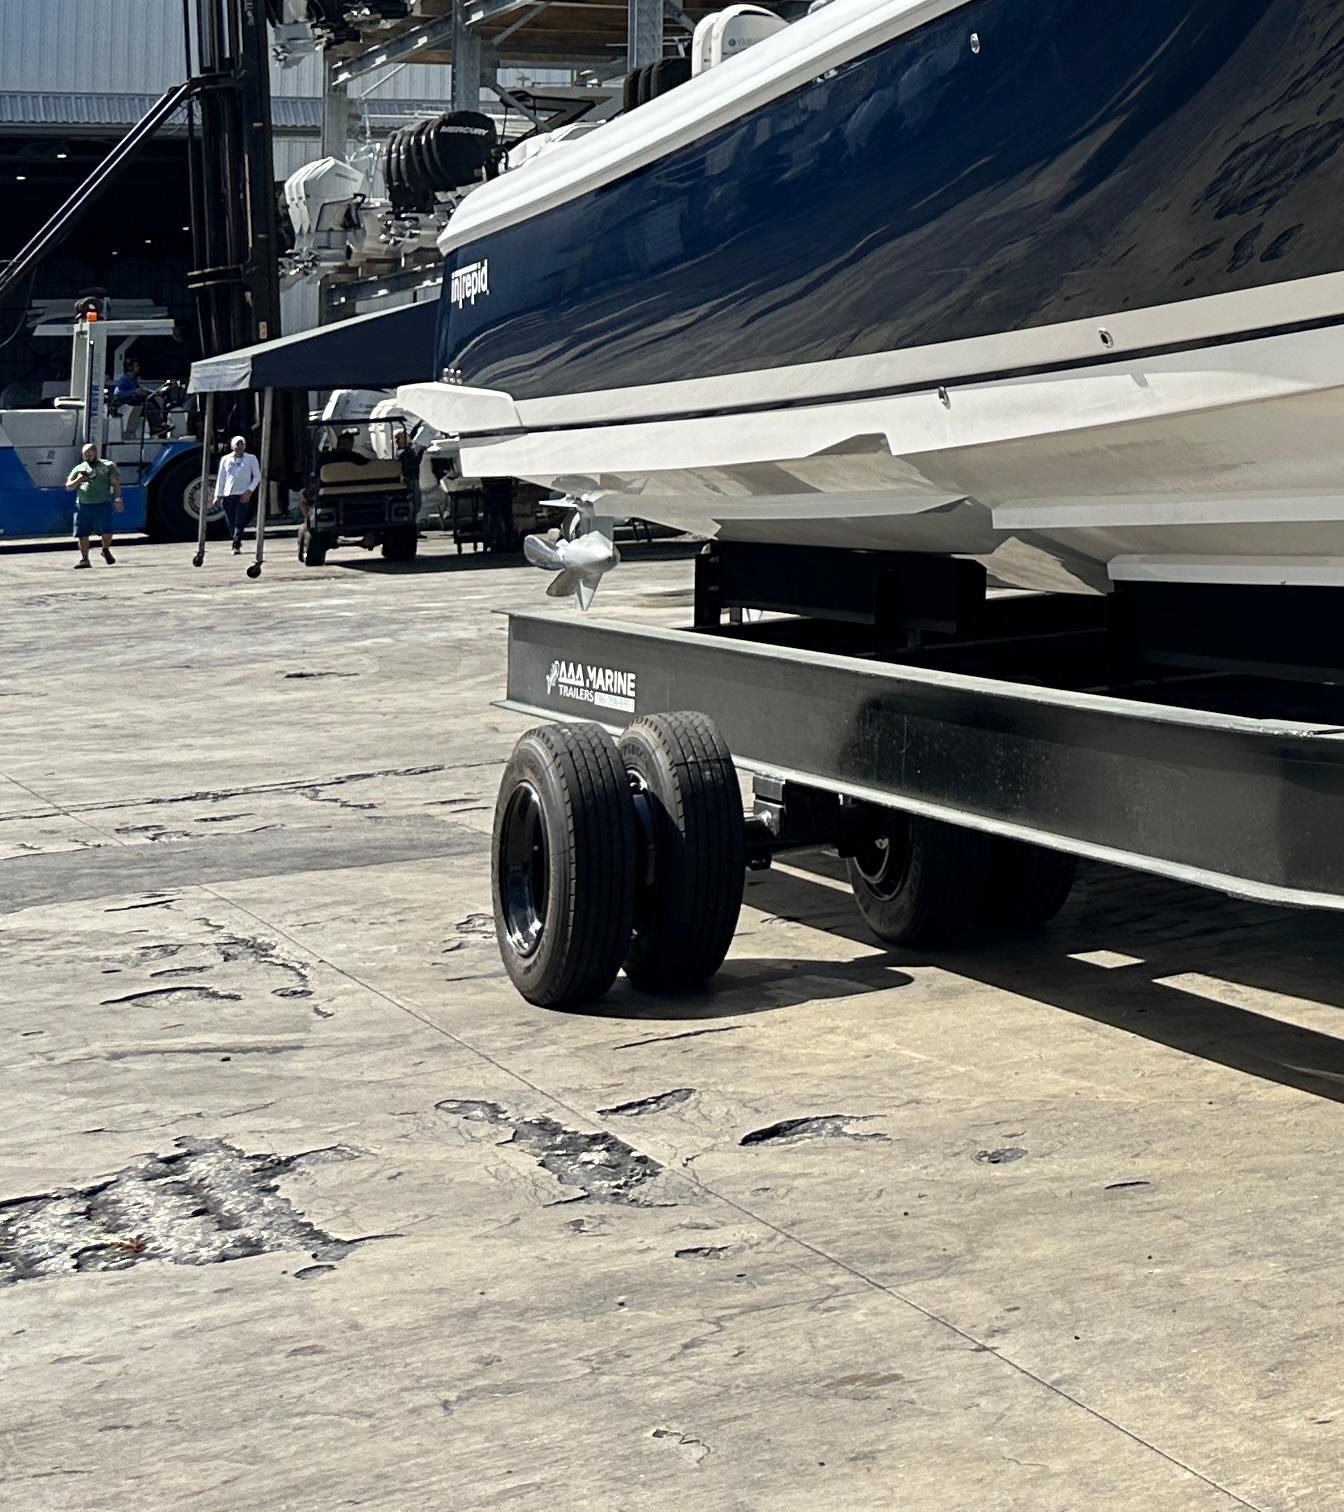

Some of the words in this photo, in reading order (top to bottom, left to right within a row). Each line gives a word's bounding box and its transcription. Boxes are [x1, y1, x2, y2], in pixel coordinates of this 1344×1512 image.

[439, 125, 489, 137] MERCURY
[586, 665, 636, 697] MARINE
[558, 684, 594, 703] TRAILERS
